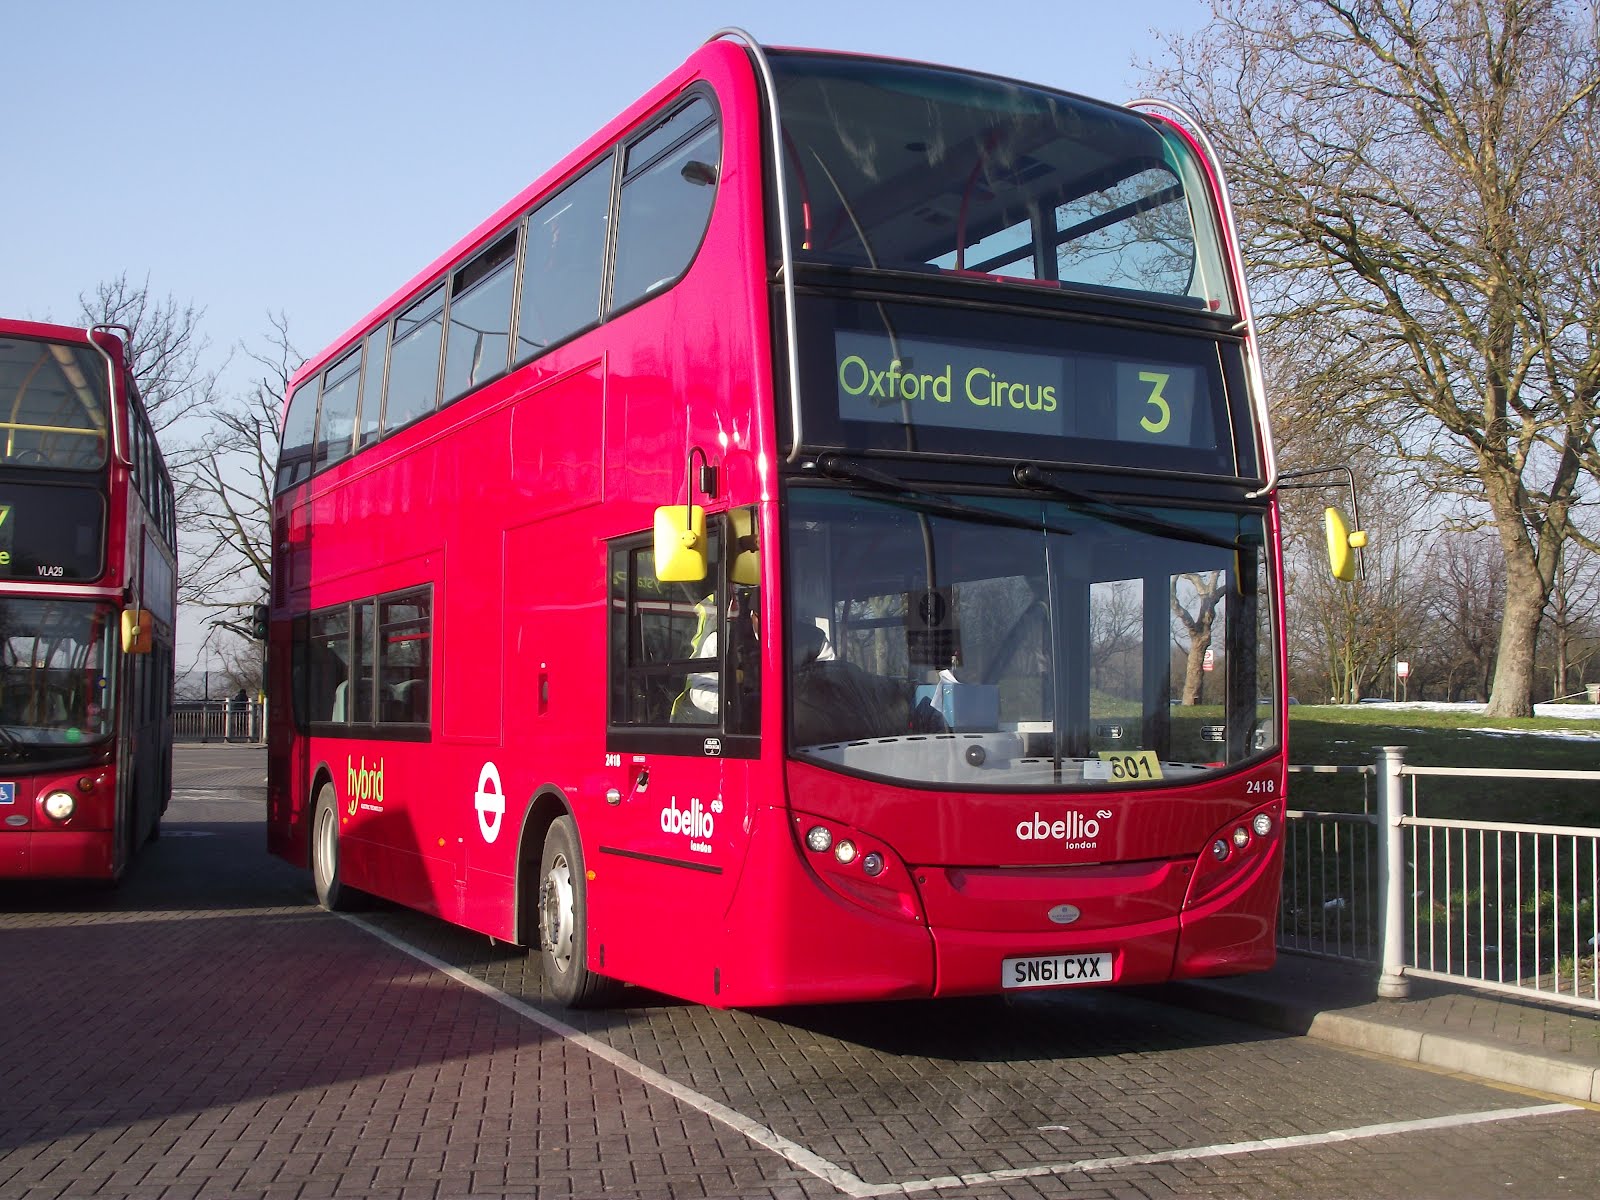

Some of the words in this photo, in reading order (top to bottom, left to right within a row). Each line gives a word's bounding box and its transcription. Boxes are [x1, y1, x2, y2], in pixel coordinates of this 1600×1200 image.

[839, 355, 951, 403] Oxford
[965, 367, 1057, 412] Circus
[1138, 371, 1171, 433] 3
[37, 565, 64, 577] VLA29
[605, 753, 621, 767] 2418
[1109, 755, 1153, 779] 601
[348, 754, 384, 816] hybrid
[1246, 780, 1275, 794] 2418
[660, 796, 714, 839] abellio
[1016, 811, 1100, 840] abellio
[690, 840, 713, 854] london
[1065, 841, 1097, 849] london
[1015, 959, 1058, 983] SN61
[1064, 957, 1100, 980] CXX
